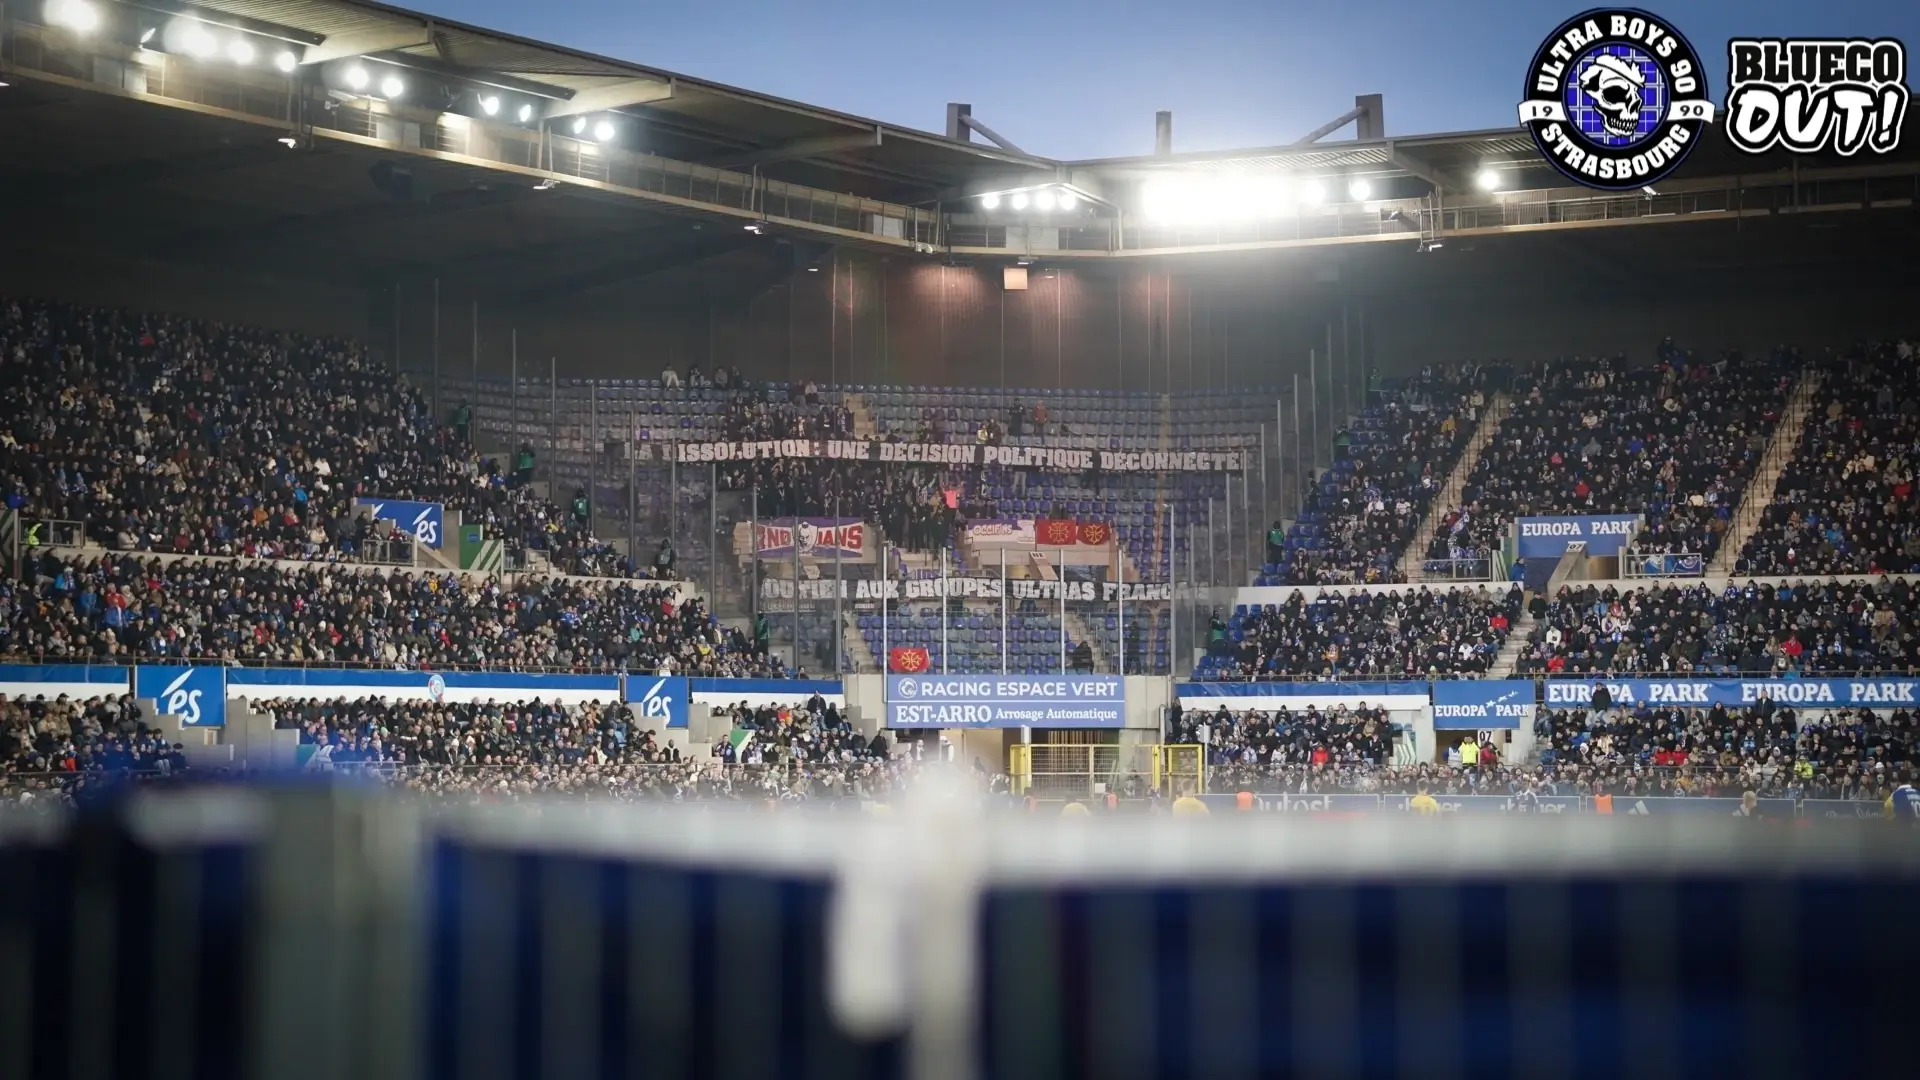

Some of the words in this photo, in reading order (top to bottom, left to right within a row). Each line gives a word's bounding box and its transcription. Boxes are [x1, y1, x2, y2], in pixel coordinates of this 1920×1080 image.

[828, 440, 869, 460] UNE
[983, 445, 1093, 468] POLITIQUE
[1522, 522, 1581, 536] EUROPA
[1591, 520, 1632, 535] PARK
[856, 579, 899, 599] AUX
[905, 577, 1002, 598] GROUPES
[1012, 580, 1096, 600] ULTRAS
[921, 682, 991, 696] RACING
[997, 682, 1066, 696] ESPACE
[1071, 682, 1118, 696] VERT
[1548, 684, 1635, 702] EURPA
[1649, 683, 1708, 702] PARK
[1741, 683, 1835, 702] EUROPA
[1850, 683, 1914, 702] PARK
[896, 705, 992, 723] EST-ARRO
[995, 707, 1044, 720] Arrosage
[1046, 707, 1117, 720] Automatique
[1435, 704, 1487, 717] EUROPA
